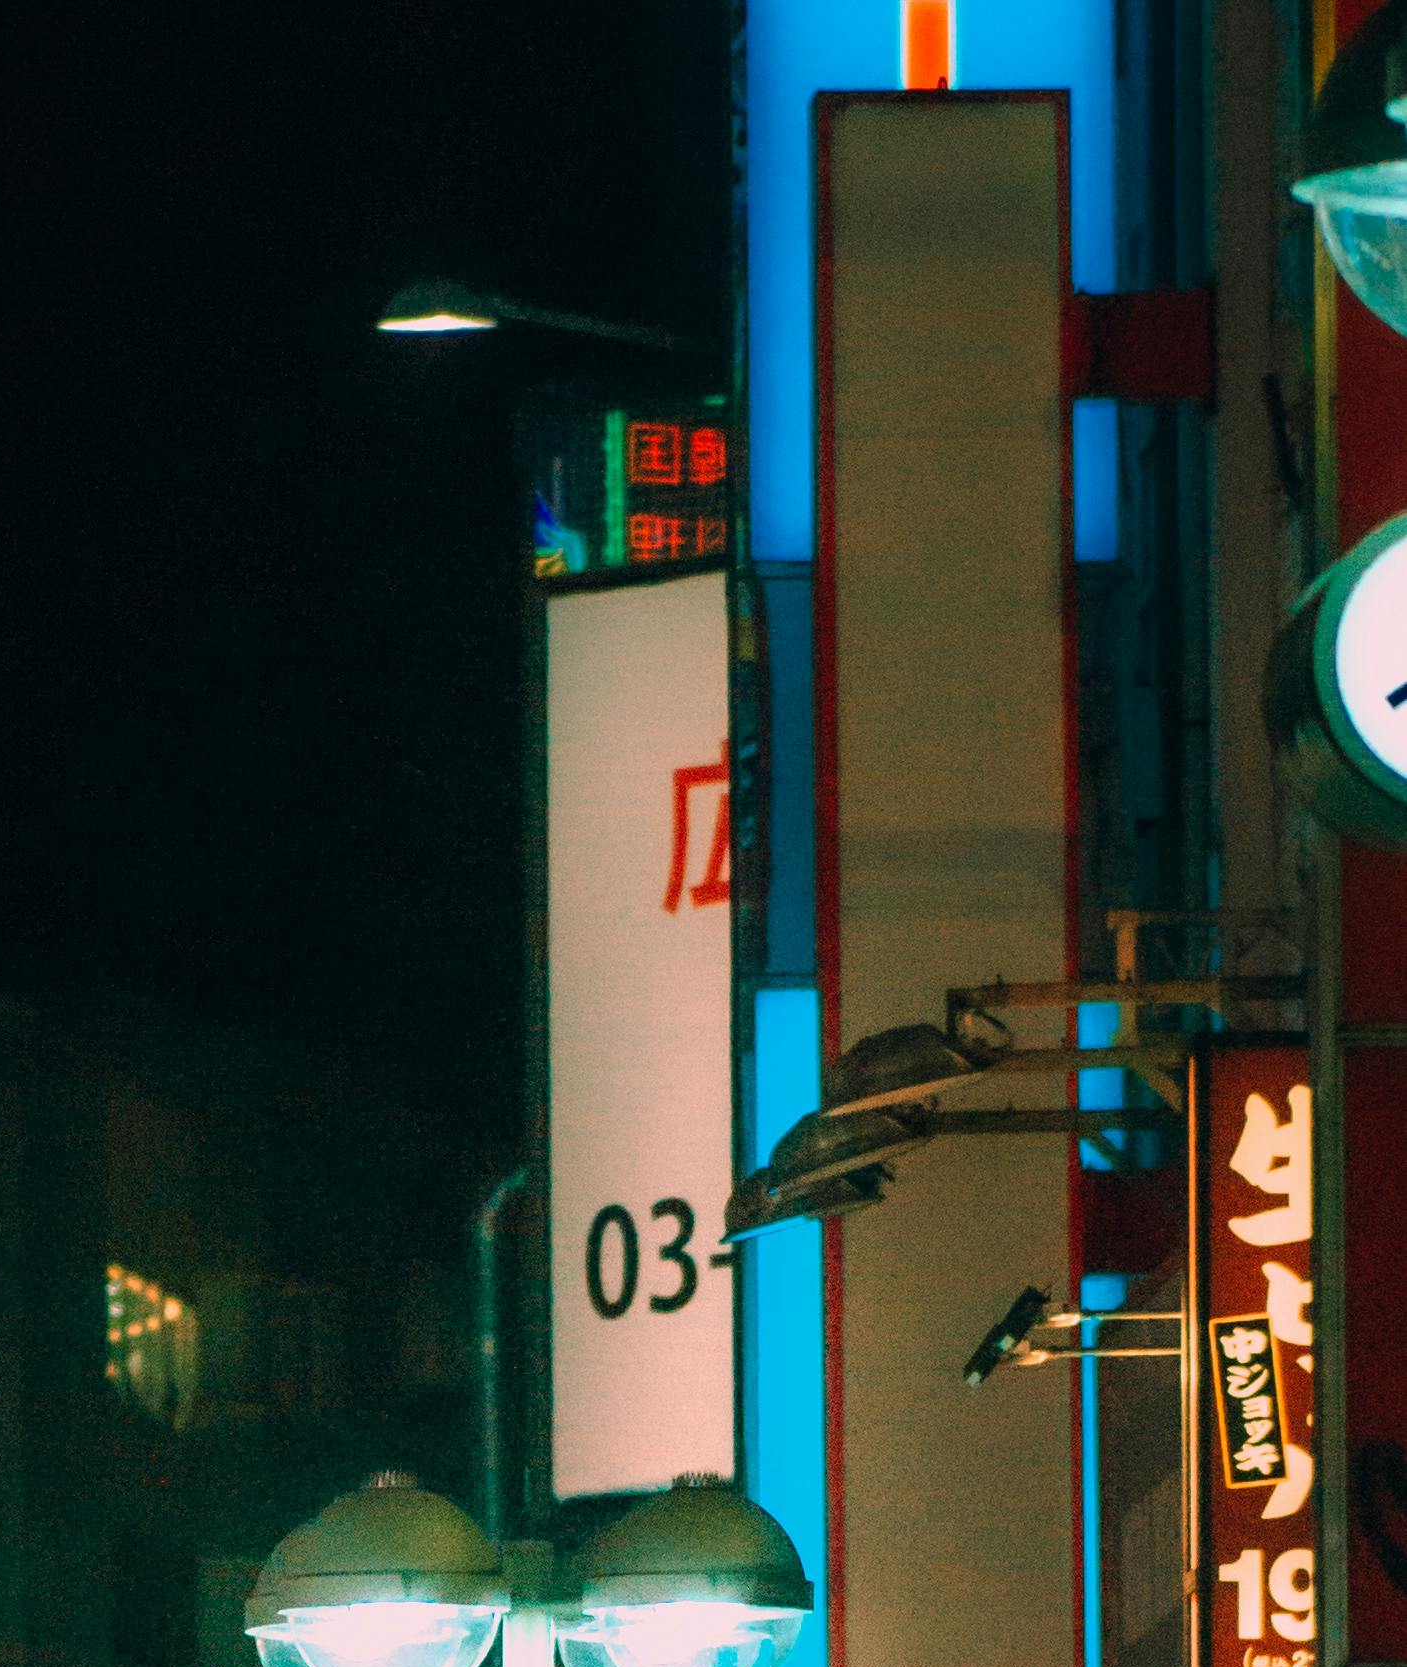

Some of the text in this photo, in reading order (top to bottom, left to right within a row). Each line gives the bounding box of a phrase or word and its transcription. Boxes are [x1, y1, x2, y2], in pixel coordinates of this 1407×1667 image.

[1220, 1327, 1281, 1476] 中ジョッキ
